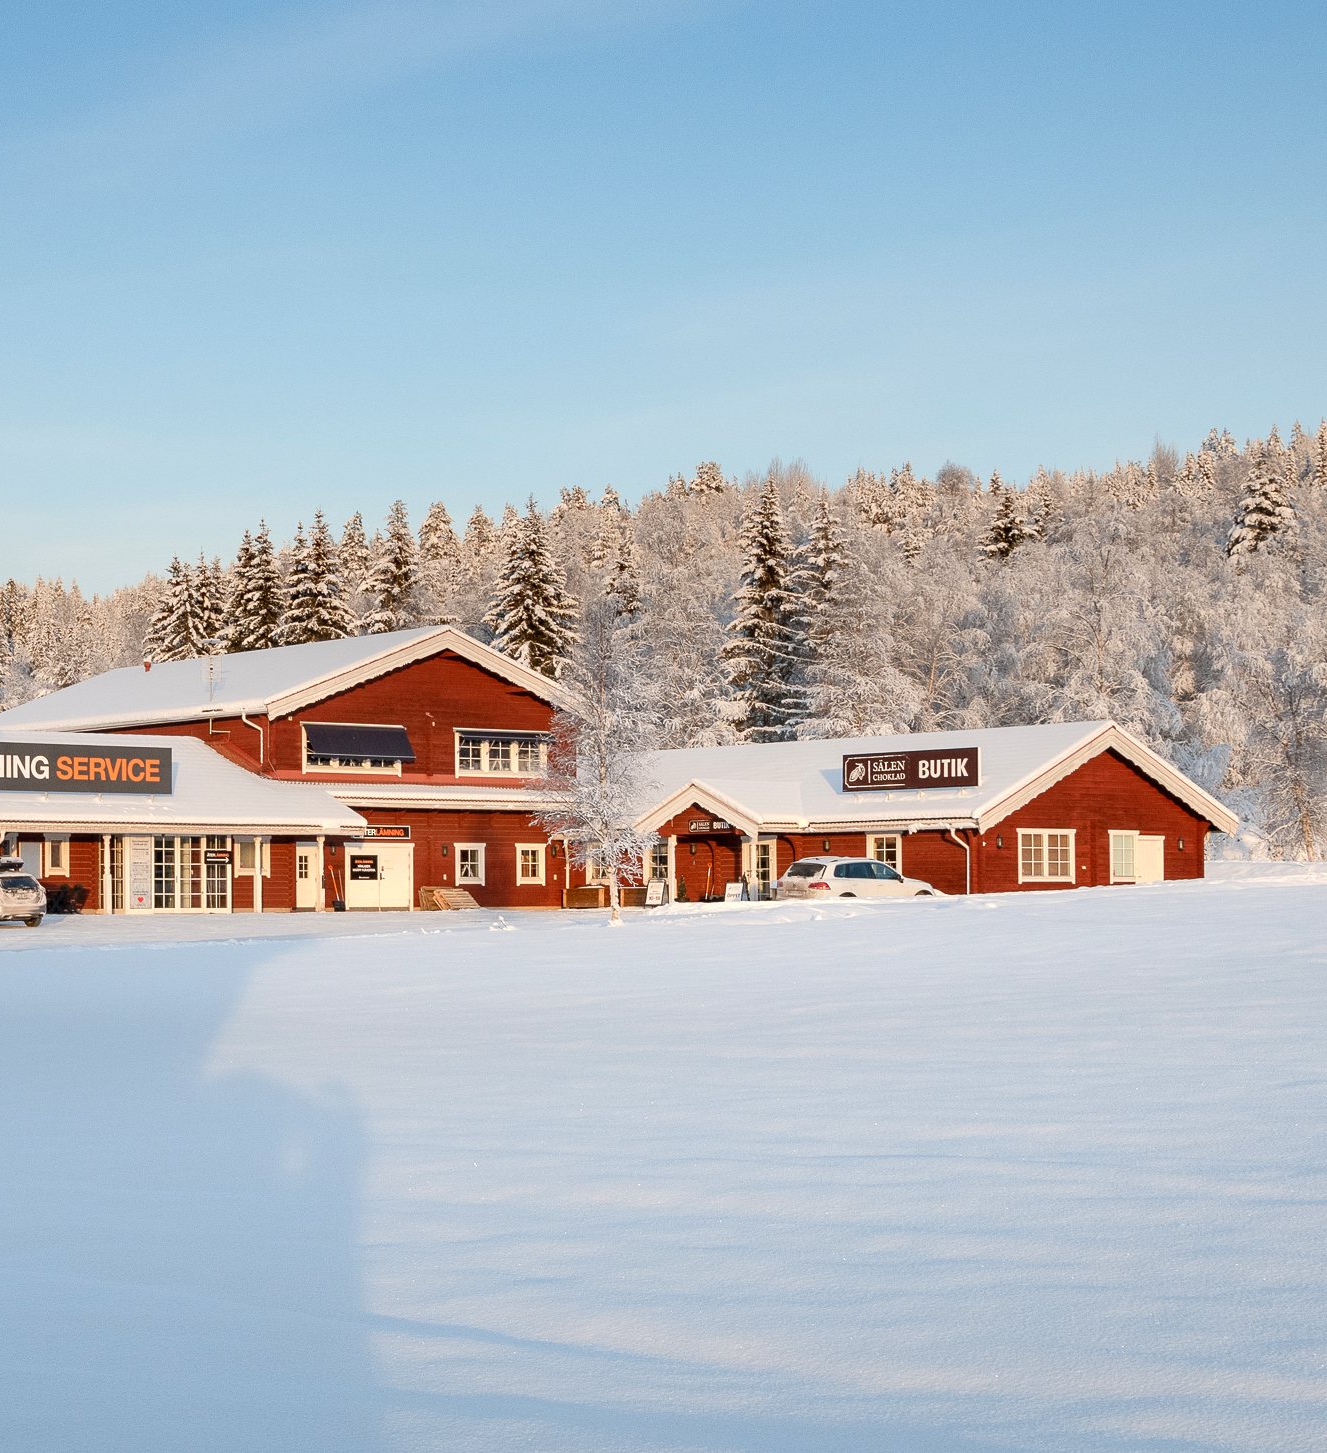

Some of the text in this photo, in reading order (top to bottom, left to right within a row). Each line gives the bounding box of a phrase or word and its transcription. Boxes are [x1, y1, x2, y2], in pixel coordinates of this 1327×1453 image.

[56, 755, 160, 782] SERVICE
[873, 759, 905, 772] SÄLEN
[918, 758, 969, 779] BUTIK
[873, 772, 906, 781] CHOKLAD
[364, 828, 404, 836] TERLÄMNING
